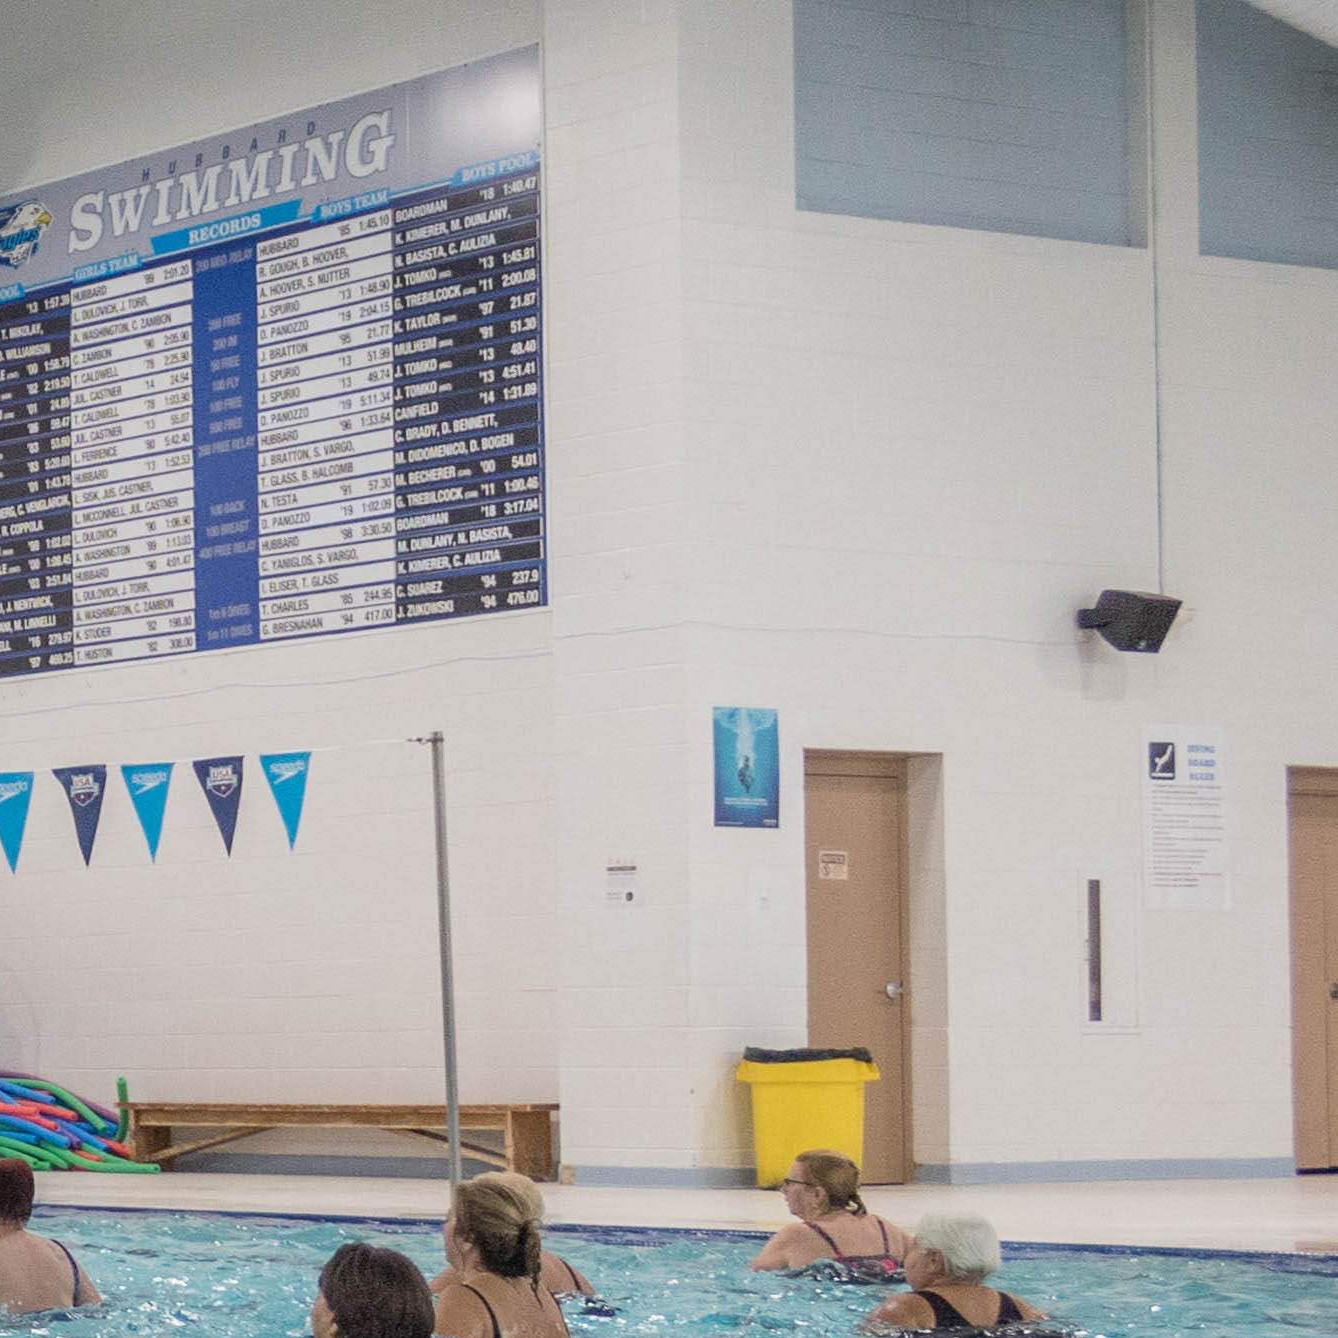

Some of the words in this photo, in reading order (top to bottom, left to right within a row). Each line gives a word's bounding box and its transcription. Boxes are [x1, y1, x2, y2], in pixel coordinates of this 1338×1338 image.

[68, 109, 396, 253] SWIMMING
[142, 121, 315, 181] HUBBARD
[188, 212, 261, 244] RECORDS
